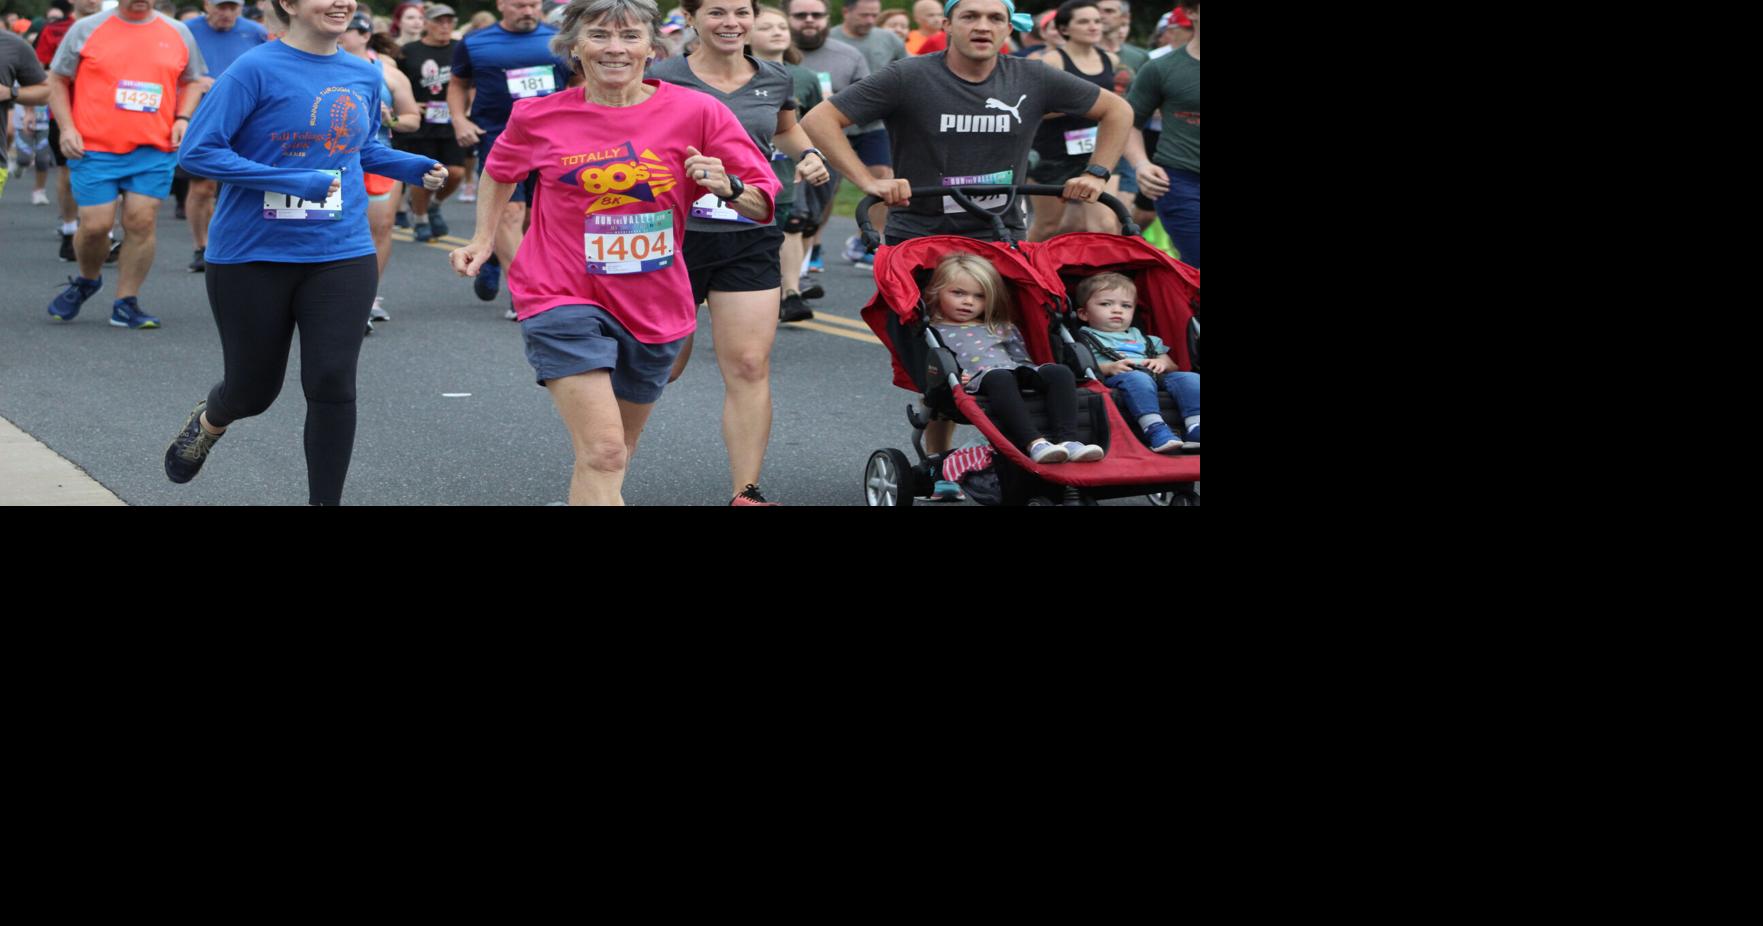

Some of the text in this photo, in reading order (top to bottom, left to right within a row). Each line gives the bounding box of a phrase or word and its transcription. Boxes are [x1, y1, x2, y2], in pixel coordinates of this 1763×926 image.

[520, 78, 544, 91] 181
[121, 91, 157, 106] 1425
[940, 113, 1010, 133] PUMA
[560, 148, 621, 166] TOTALLY
[601, 196, 622, 206] 8K
[595, 215, 612, 225] RUN
[591, 231, 668, 261] 1404
